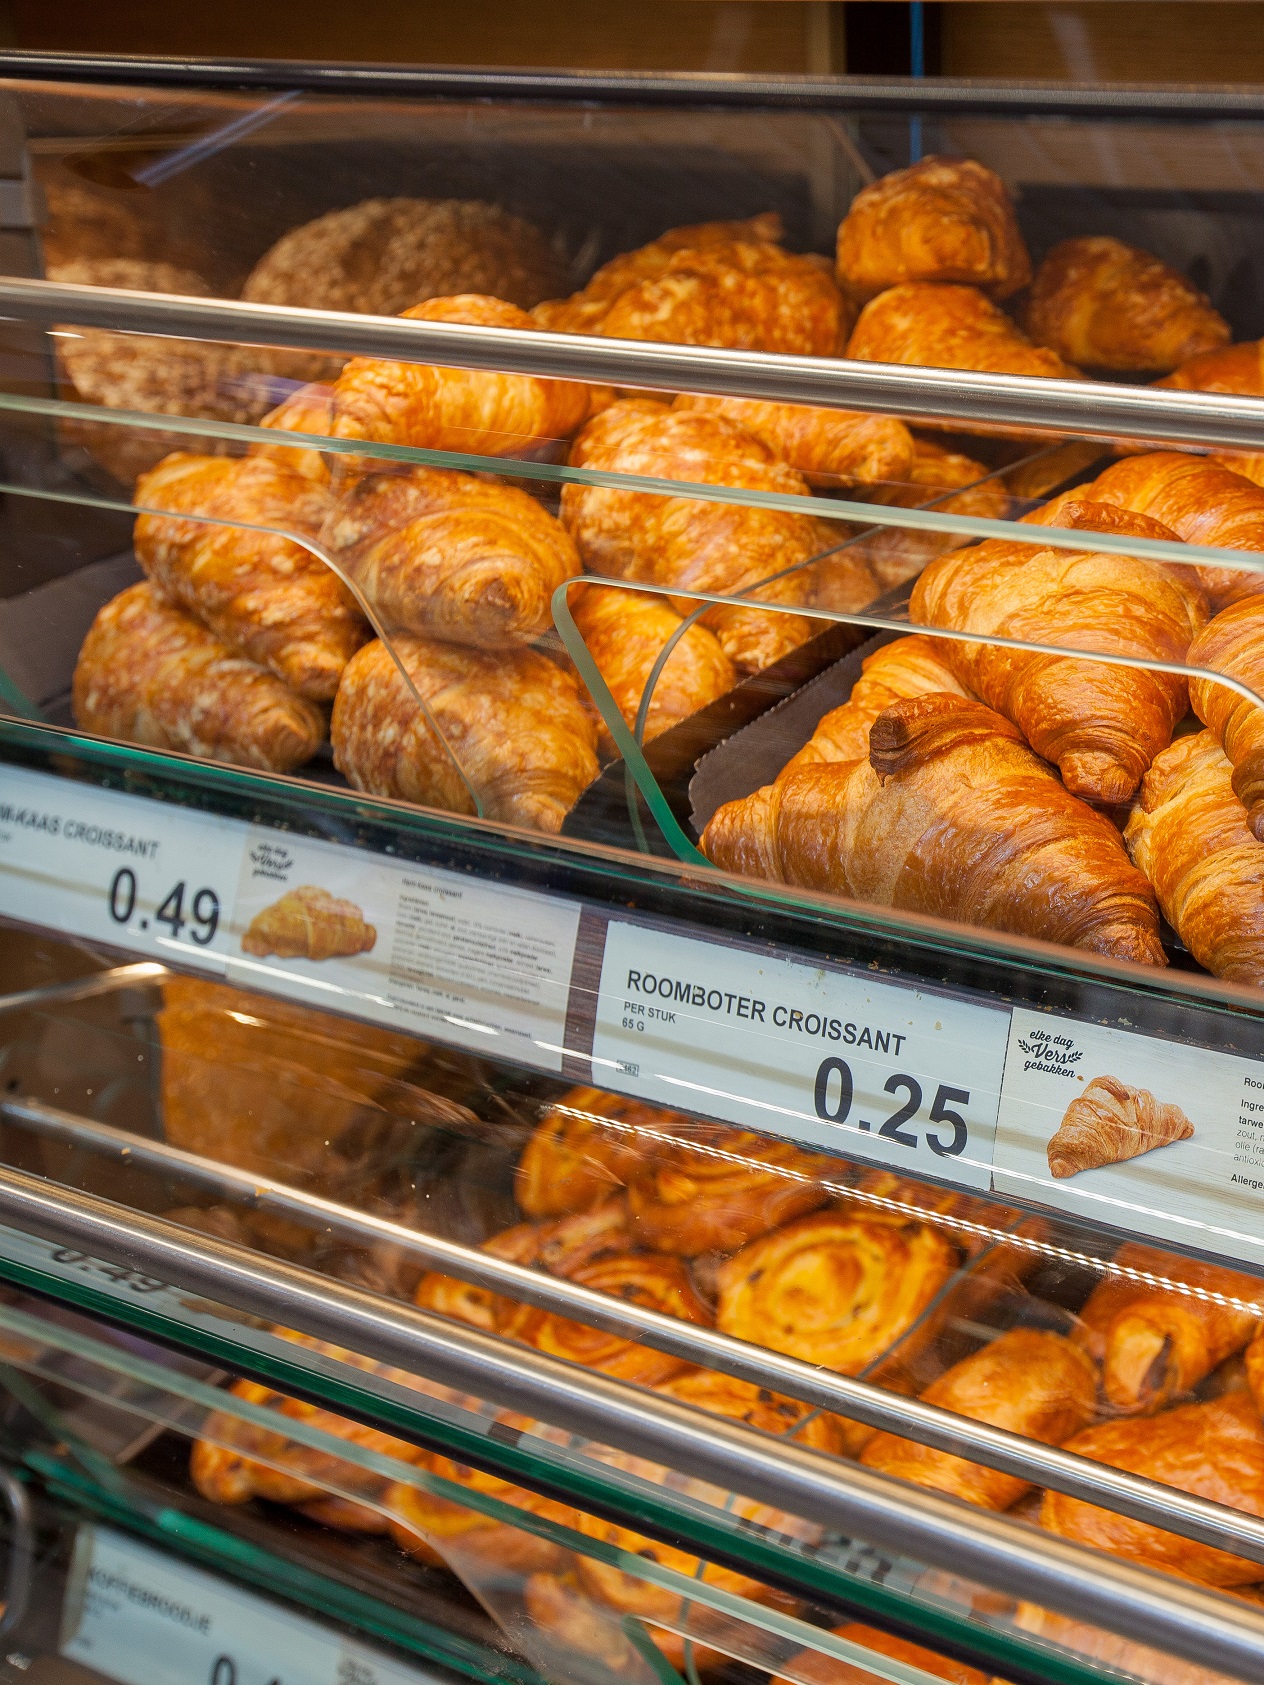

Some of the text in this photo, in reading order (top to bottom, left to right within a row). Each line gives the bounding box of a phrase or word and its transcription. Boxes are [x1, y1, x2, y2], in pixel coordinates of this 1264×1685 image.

[63, 818, 160, 858] CROISSANT
[110, 868, 219, 945] 0.49
[624, 1001, 676, 1024] PER STUK
[627, 969, 906, 1056] ROOMBOTER CROISSANT
[622, 1017, 645, 1032] 65 G
[1030, 1030, 1074, 1051] elke dag
[1031, 1043, 1069, 1064] Vers
[1024, 1060, 1075, 1078] gebakken
[814, 1056, 970, 1158] 0.25
[1235, 1140, 1251, 1151] olie
[1236, 1129, 1257, 1141] zout,
